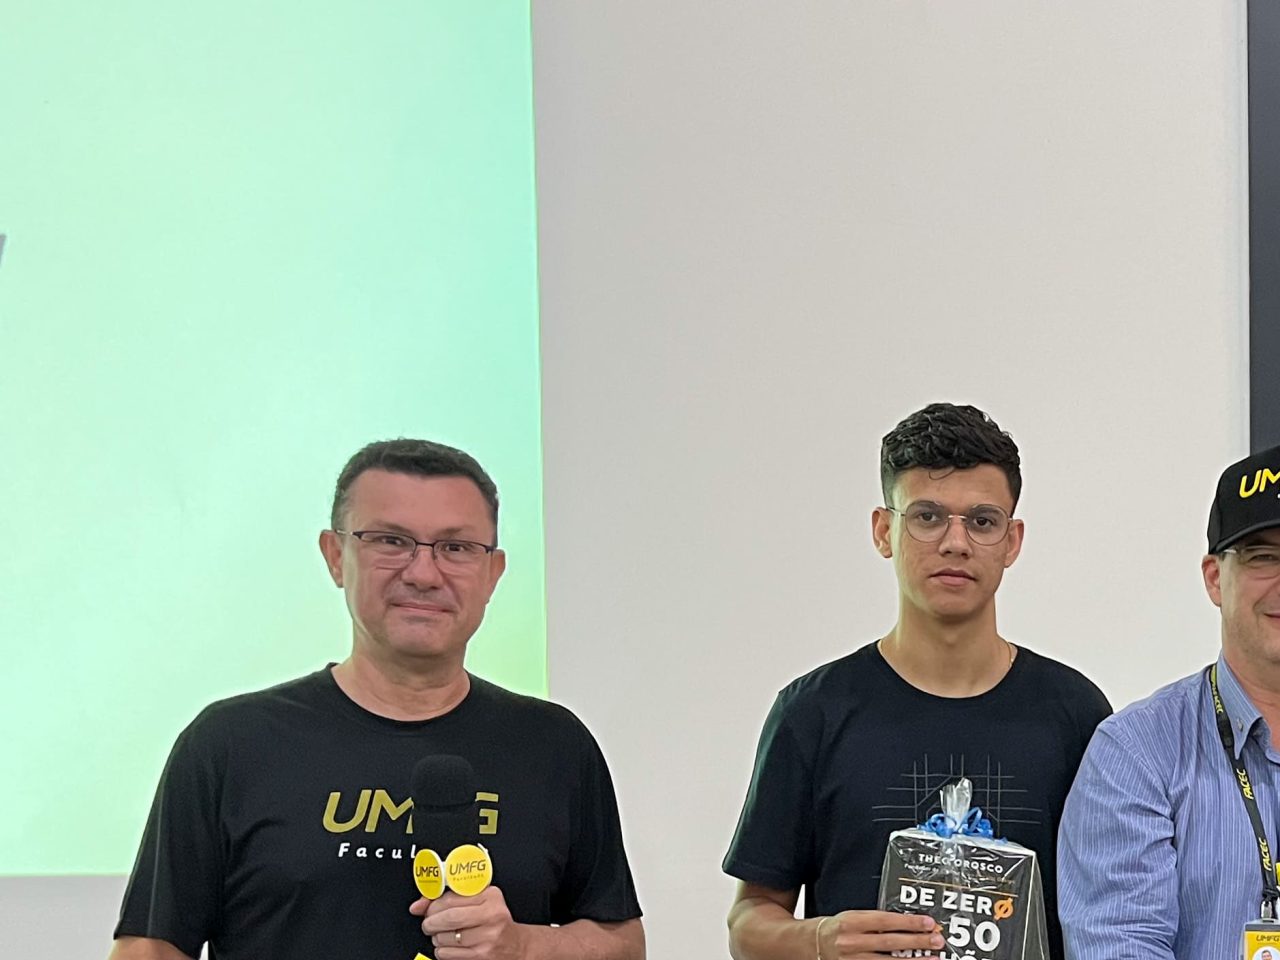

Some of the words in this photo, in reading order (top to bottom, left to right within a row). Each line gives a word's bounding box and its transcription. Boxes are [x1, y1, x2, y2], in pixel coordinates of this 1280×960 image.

[322, 789, 499, 835] UMG
[338, 842, 416, 860] Facul
[415, 866, 439, 878] UMFG
[449, 859, 487, 875] UMFG
[954, 857, 1004, 874] OROSCO
[900, 885, 936, 907] DE
[947, 915, 1001, 952] 50
[1256, 934, 1280, 942] UMFG
